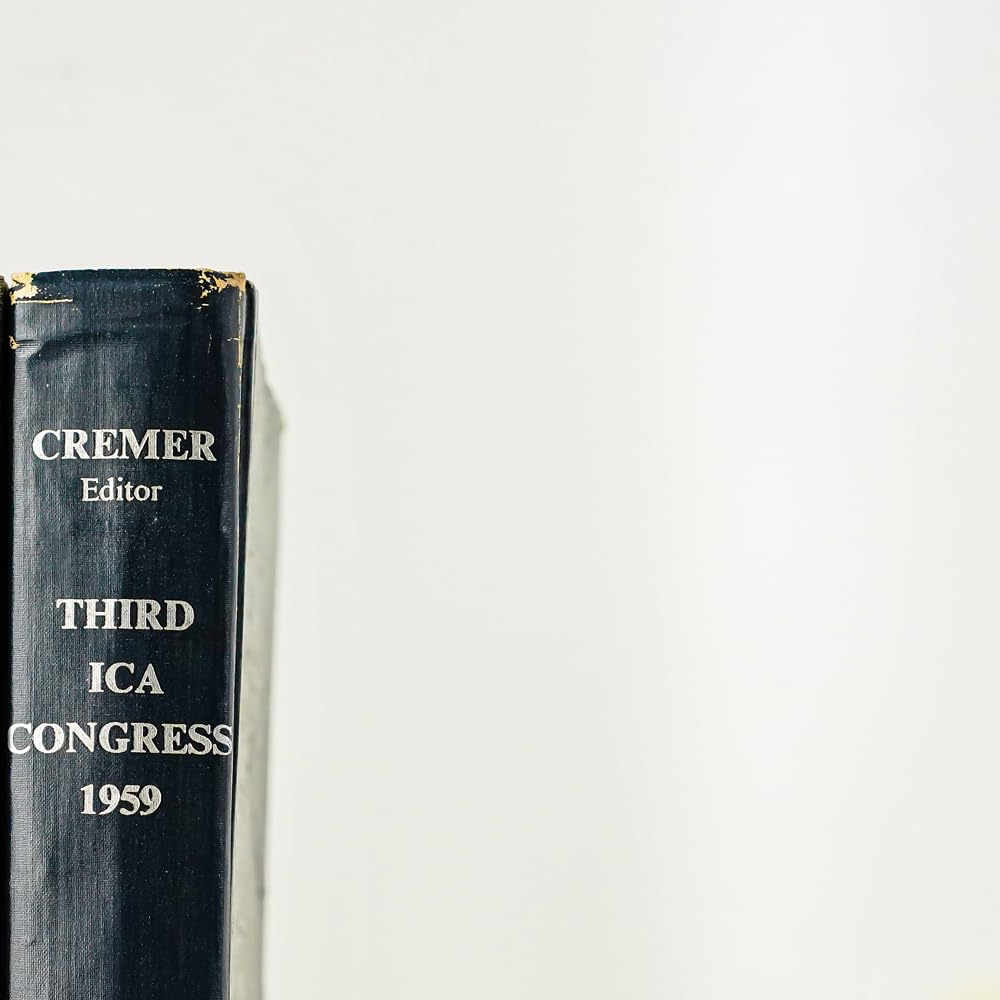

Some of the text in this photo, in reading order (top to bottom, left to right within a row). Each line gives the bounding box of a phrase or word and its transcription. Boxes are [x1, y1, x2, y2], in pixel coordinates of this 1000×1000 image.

[31, 429, 218, 463] CREMER
[80, 476, 163, 502] Editor
[56, 598, 195, 631] THIRD
[88, 662, 165, 694] ICA
[8, 721, 234, 756] CONGRESS
[80, 783, 163, 816] 1959
